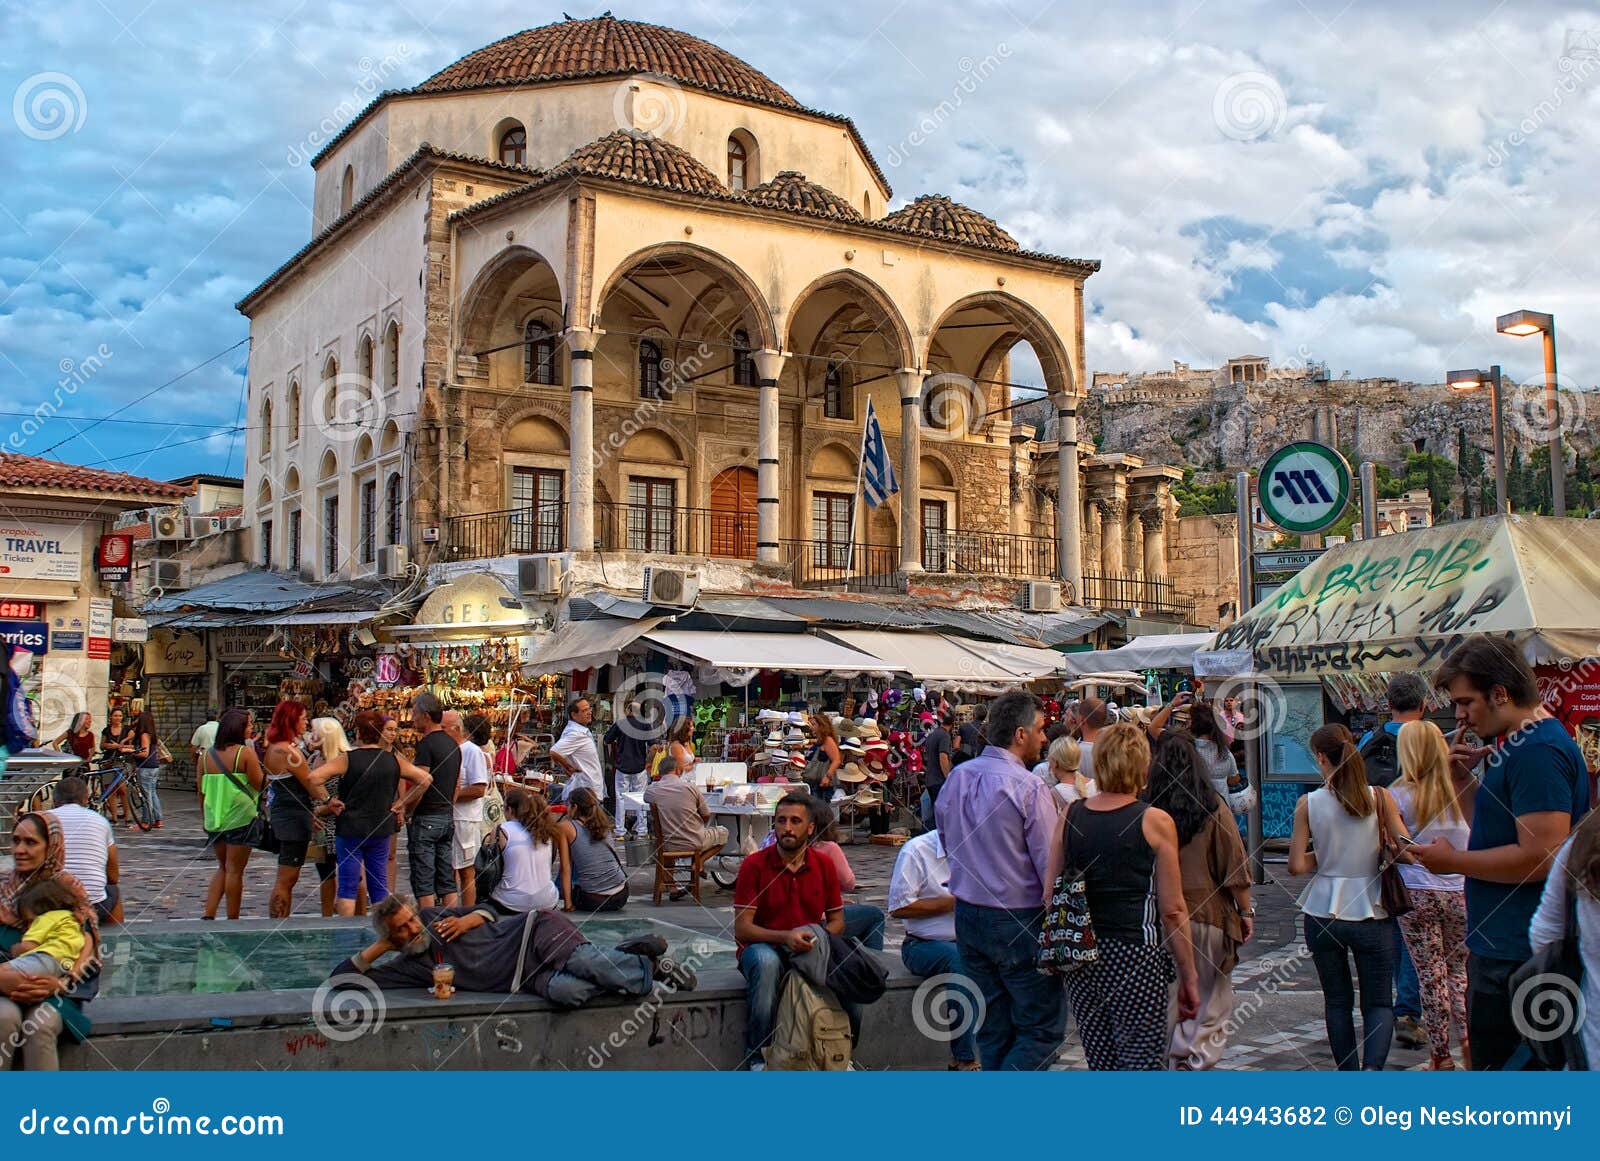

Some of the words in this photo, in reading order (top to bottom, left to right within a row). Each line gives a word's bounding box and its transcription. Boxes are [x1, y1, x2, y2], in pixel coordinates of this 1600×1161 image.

[6, 538, 63, 554] TRAVEL
[3, 554, 34, 562] Tickets
[377, 654, 400, 682] 10
